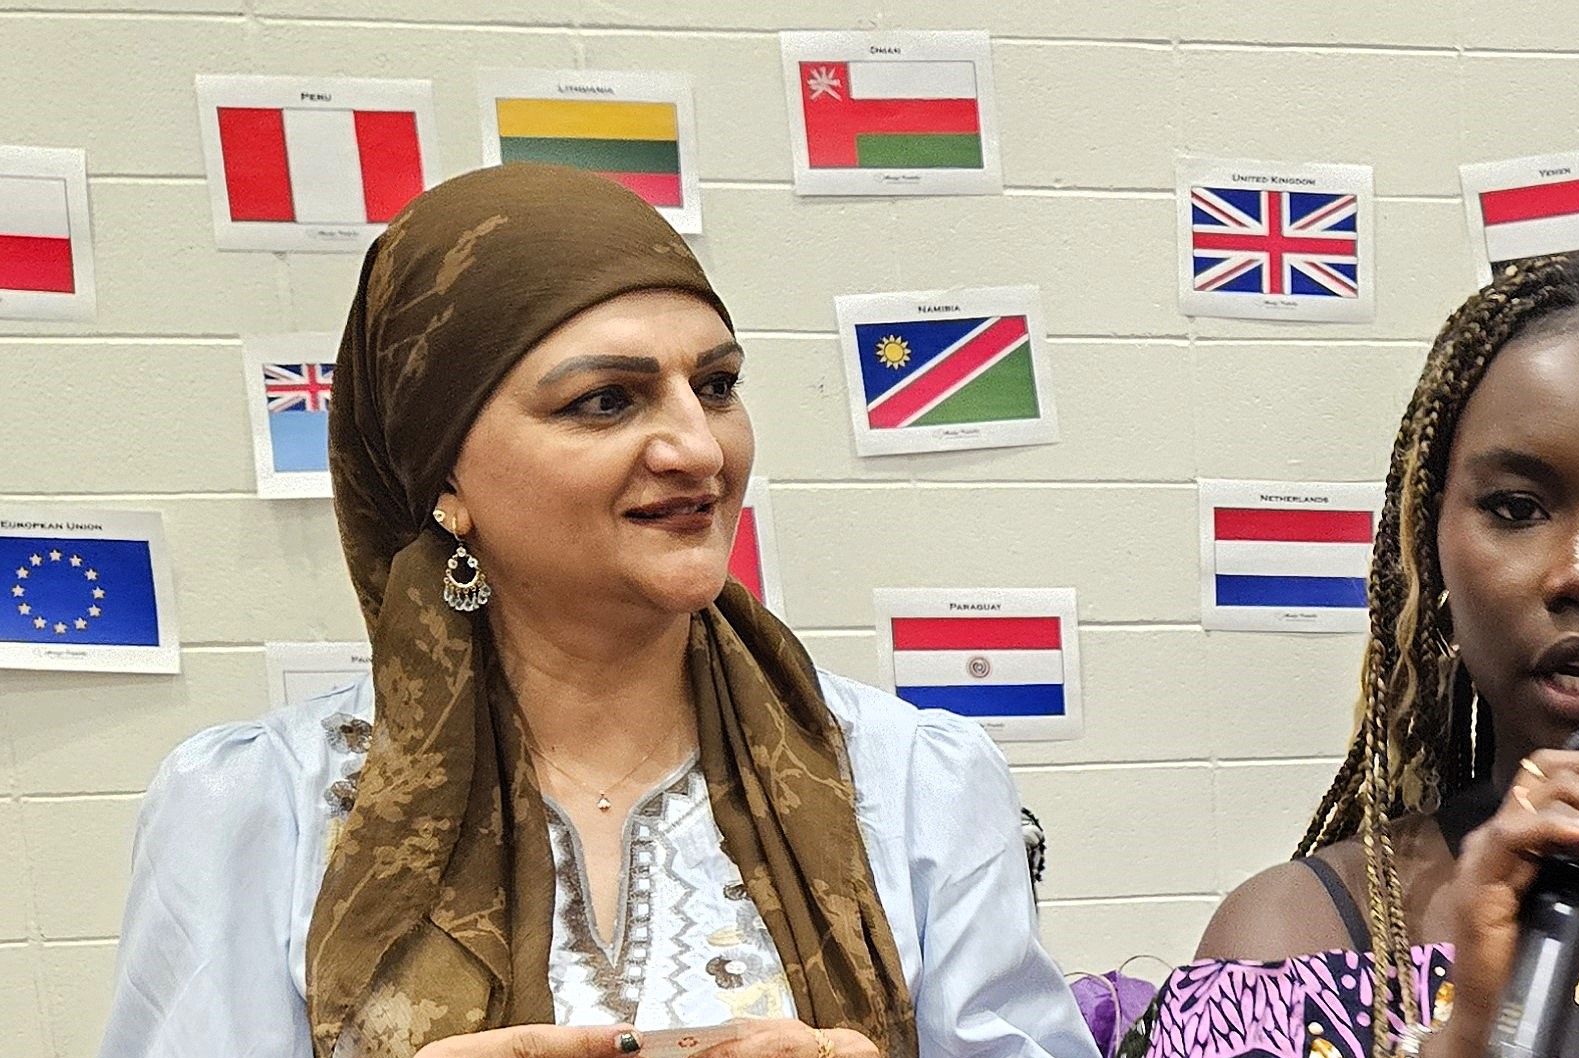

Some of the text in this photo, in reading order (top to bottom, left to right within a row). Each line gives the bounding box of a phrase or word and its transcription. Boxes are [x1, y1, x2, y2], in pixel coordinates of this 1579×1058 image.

[300, 92, 332, 102] PERU
[1232, 174, 1316, 187] UNITED KINGDOM
[917, 304, 961, 315] NAMIBIA
[1259, 494, 1329, 504] NETHERLANDS
[0, 520, 103, 532] EUROPEAN UNION
[949, 602, 1000, 613] PARAGUAY
